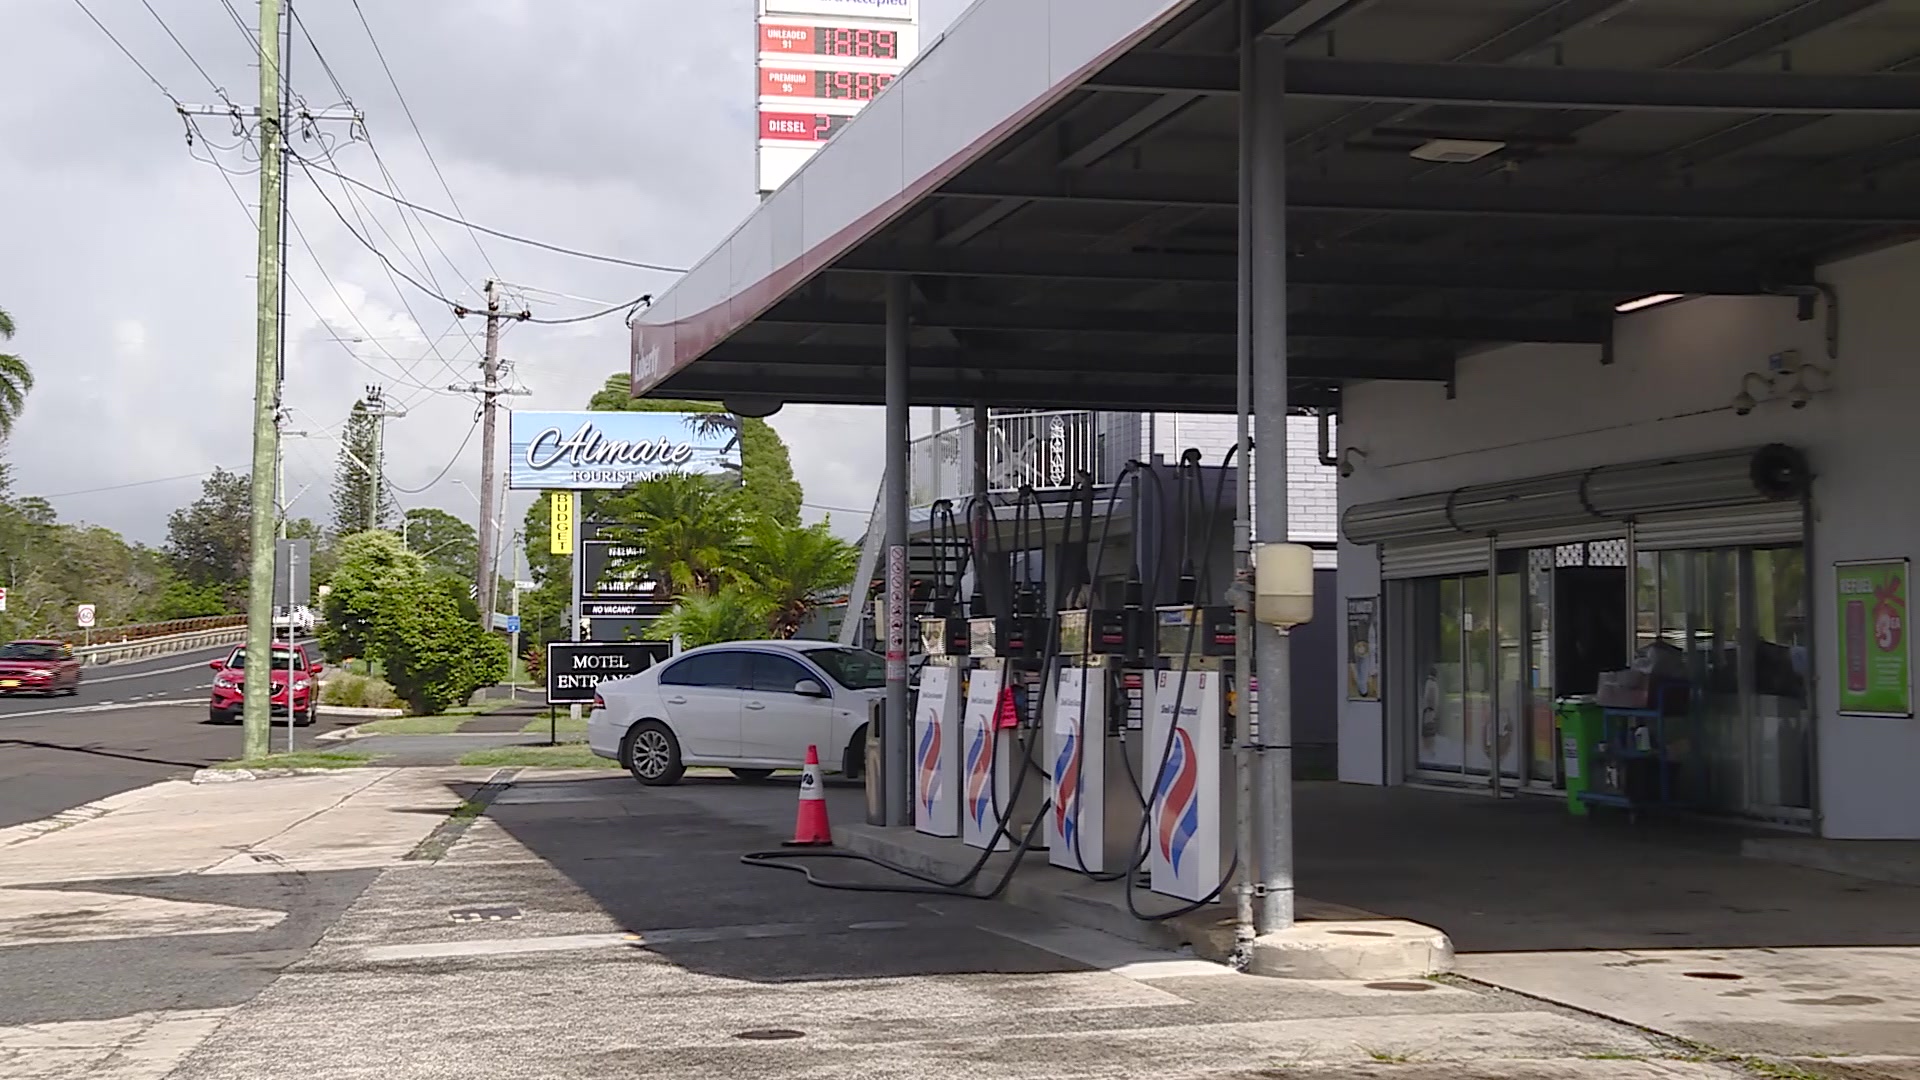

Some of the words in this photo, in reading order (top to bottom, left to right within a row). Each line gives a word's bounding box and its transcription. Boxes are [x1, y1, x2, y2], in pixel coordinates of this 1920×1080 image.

[767, 29, 807, 40] UNLEADED
[782, 40, 792, 49] 91
[769, 73, 806, 84] PREMIUM
[782, 84, 793, 92] 95
[769, 120, 807, 133] DIESEL
[526, 420, 692, 469] Almare
[571, 470, 637, 483] TOURIST
[557, 493, 568, 550] BUDGET
[592, 605, 603, 614] NO
[604, 605, 636, 614] VACANCY
[572, 655, 630, 669] MOTEL
